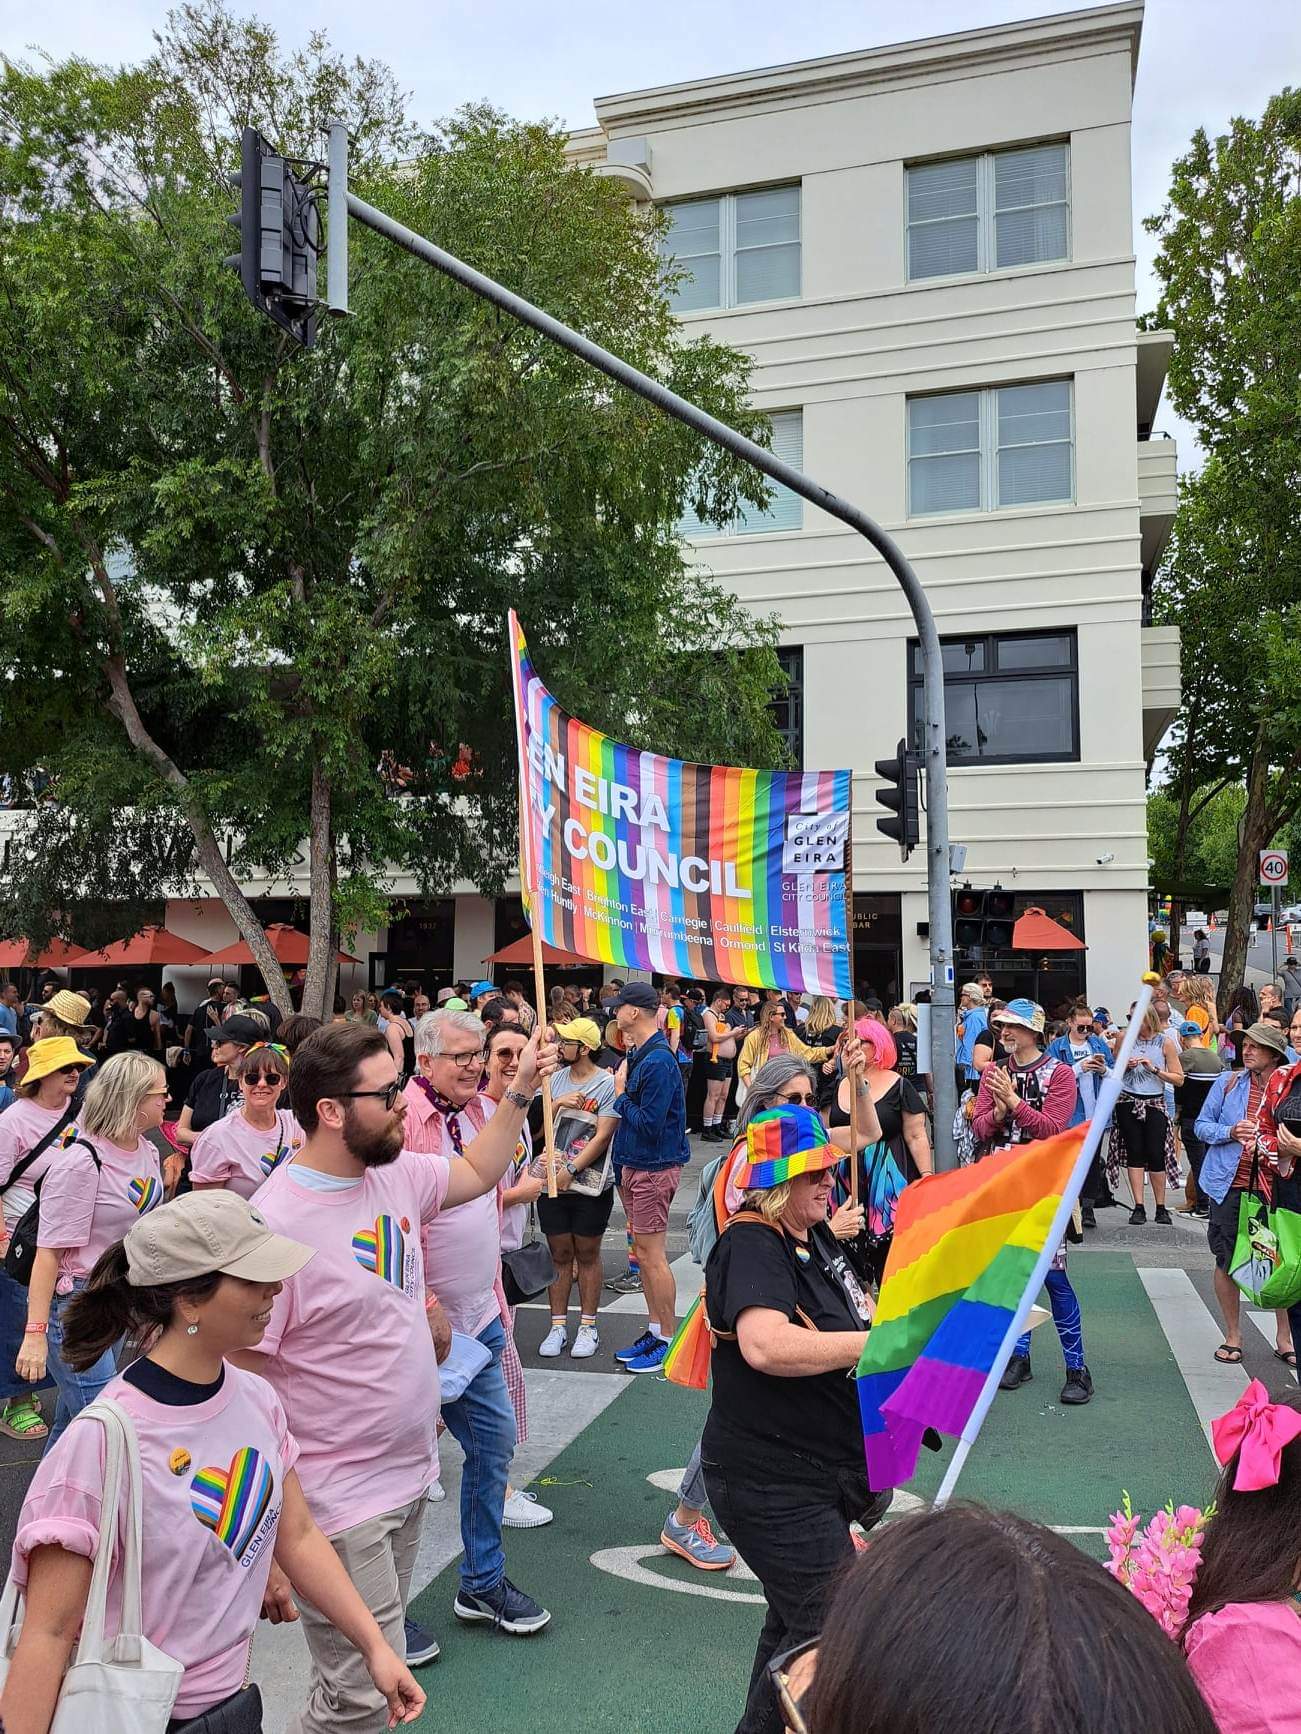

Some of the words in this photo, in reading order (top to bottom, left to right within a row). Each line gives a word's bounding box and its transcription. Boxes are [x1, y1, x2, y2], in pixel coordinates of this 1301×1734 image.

[528, 731, 566, 792] EN
[575, 765, 671, 833] EIRA
[795, 822, 821, 833] City
[826, 822, 838, 832] of
[794, 836, 837, 846] GLEN
[563, 818, 752, 899] COUNCIL
[794, 853, 836, 863] EIRA
[1265, 862, 1284, 874] 40
[782, 881, 815, 891] GLEN
[820, 881, 848, 891] EIRA
[782, 893, 804, 901] CITY
[561, 877, 582, 897] East
[587, 889, 629, 913] Brighton
[660, 911, 708, 930] Carnegie
[714, 920, 763, 935] Caulfield
[770, 925, 841, 937] Elsternwick
[551, 890, 577, 914] Huntly
[583, 905, 633, 930] McKinnon
[719, 936, 766, 951] Ormond
[773, 942, 786, 953] St
[822, 942, 851, 953] East
[853, 912, 879, 920] UBLIC
[241, 1535, 263, 1568] GLEN
[260, 1509, 275, 1535] EIRA
